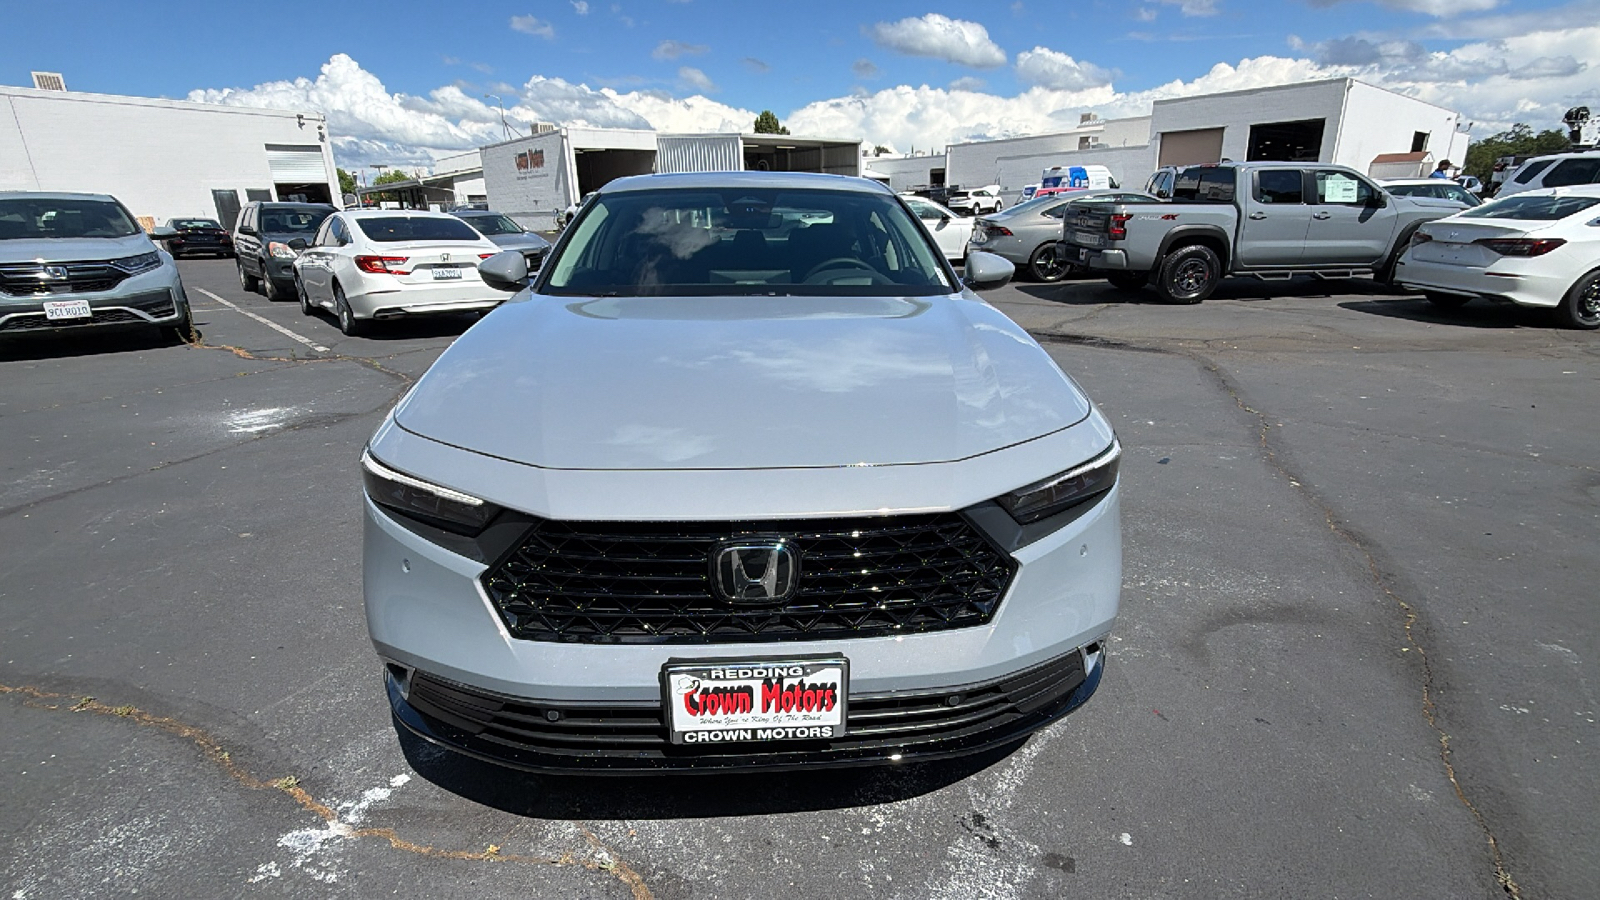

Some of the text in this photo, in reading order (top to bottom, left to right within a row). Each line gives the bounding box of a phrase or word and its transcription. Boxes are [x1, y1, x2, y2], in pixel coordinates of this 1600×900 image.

[711, 667, 804, 680] REDDING
[684, 678, 837, 716] Crown Motors
[751, 715, 770, 723] King
[772, 715, 783, 723] Of
[684, 726, 833, 743] CROWN MOTORS
